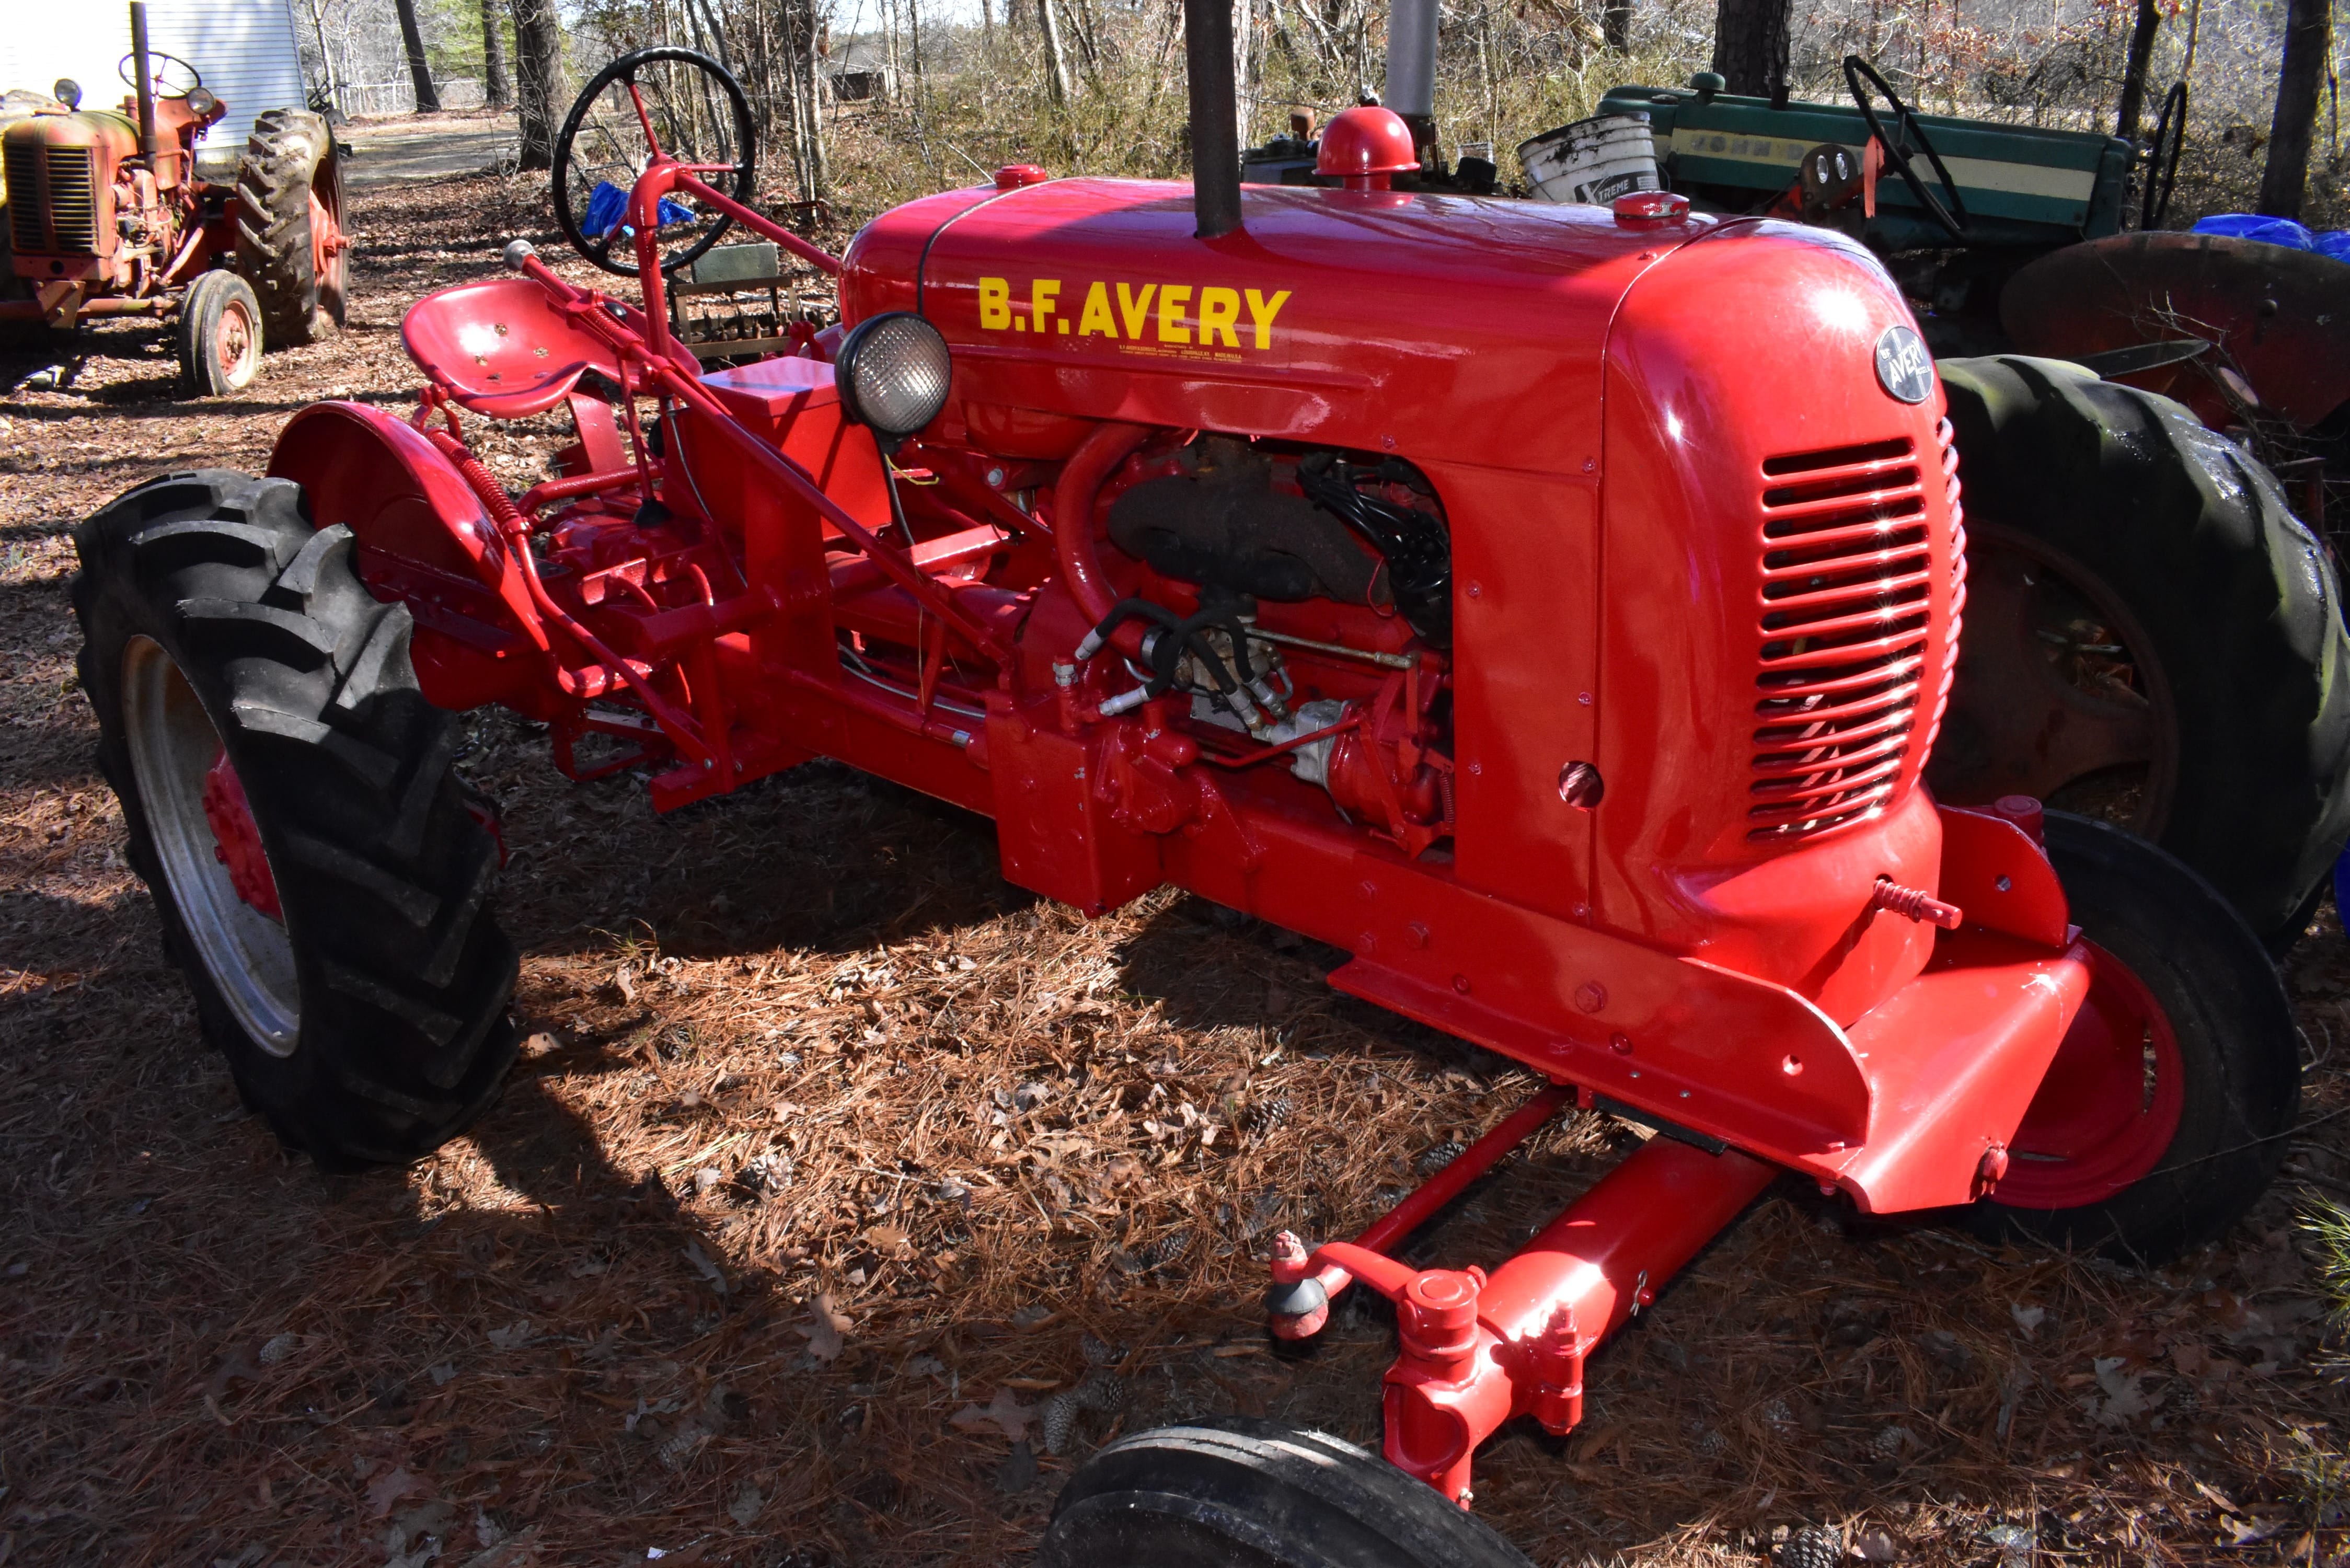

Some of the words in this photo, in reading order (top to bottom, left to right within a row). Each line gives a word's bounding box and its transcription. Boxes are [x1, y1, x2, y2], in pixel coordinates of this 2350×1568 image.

[978, 277, 1069, 335] B.F.
[1078, 281, 1292, 350] AVERY
[1890, 336, 1923, 389] AVERY
